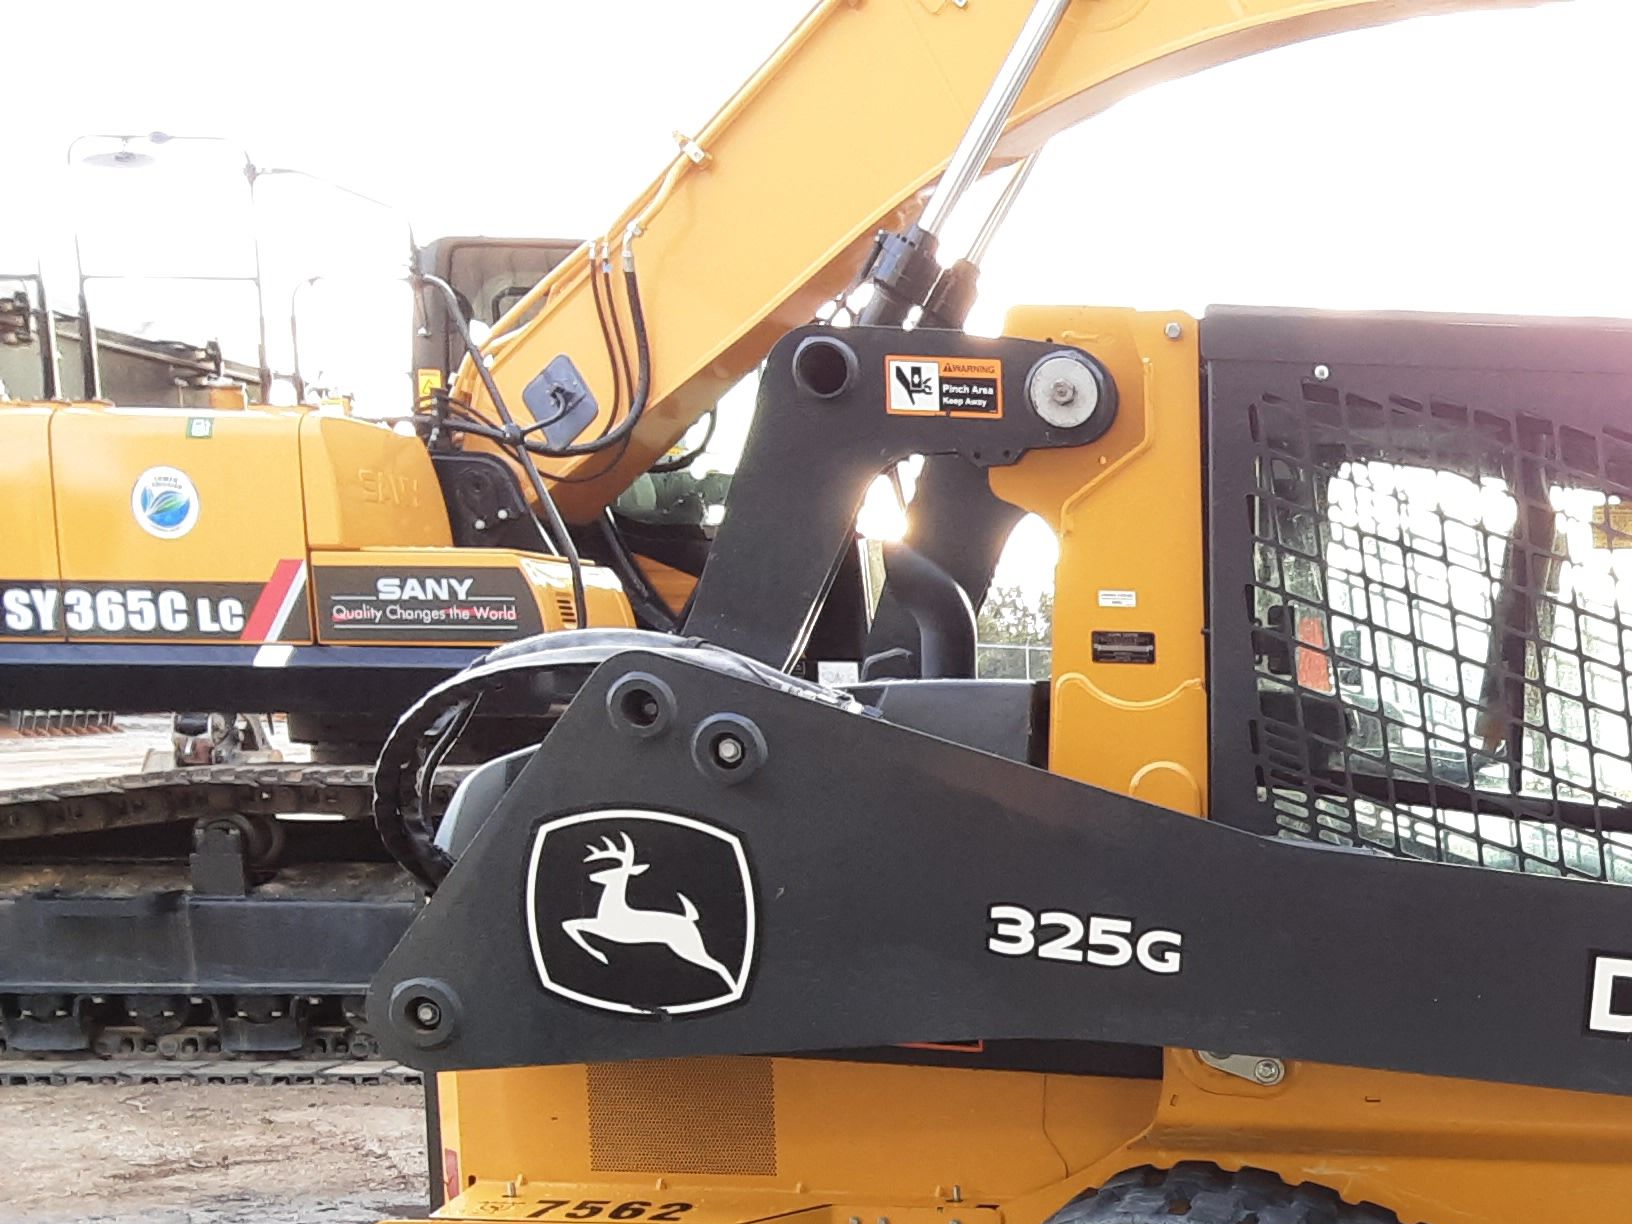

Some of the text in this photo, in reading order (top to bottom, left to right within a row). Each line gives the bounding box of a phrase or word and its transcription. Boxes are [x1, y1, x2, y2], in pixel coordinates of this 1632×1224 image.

[952, 364, 996, 374] WARNING
[942, 383, 994, 395] Pinch Area
[942, 396, 988, 408] Keep Away
[376, 577, 474, 601] SANY
[197, 598, 245, 632] LC
[332, 603, 517, 623] Quality Changes the World
[989, 905, 1182, 973] 325G
[526, 1200, 693, 1221] 7562
